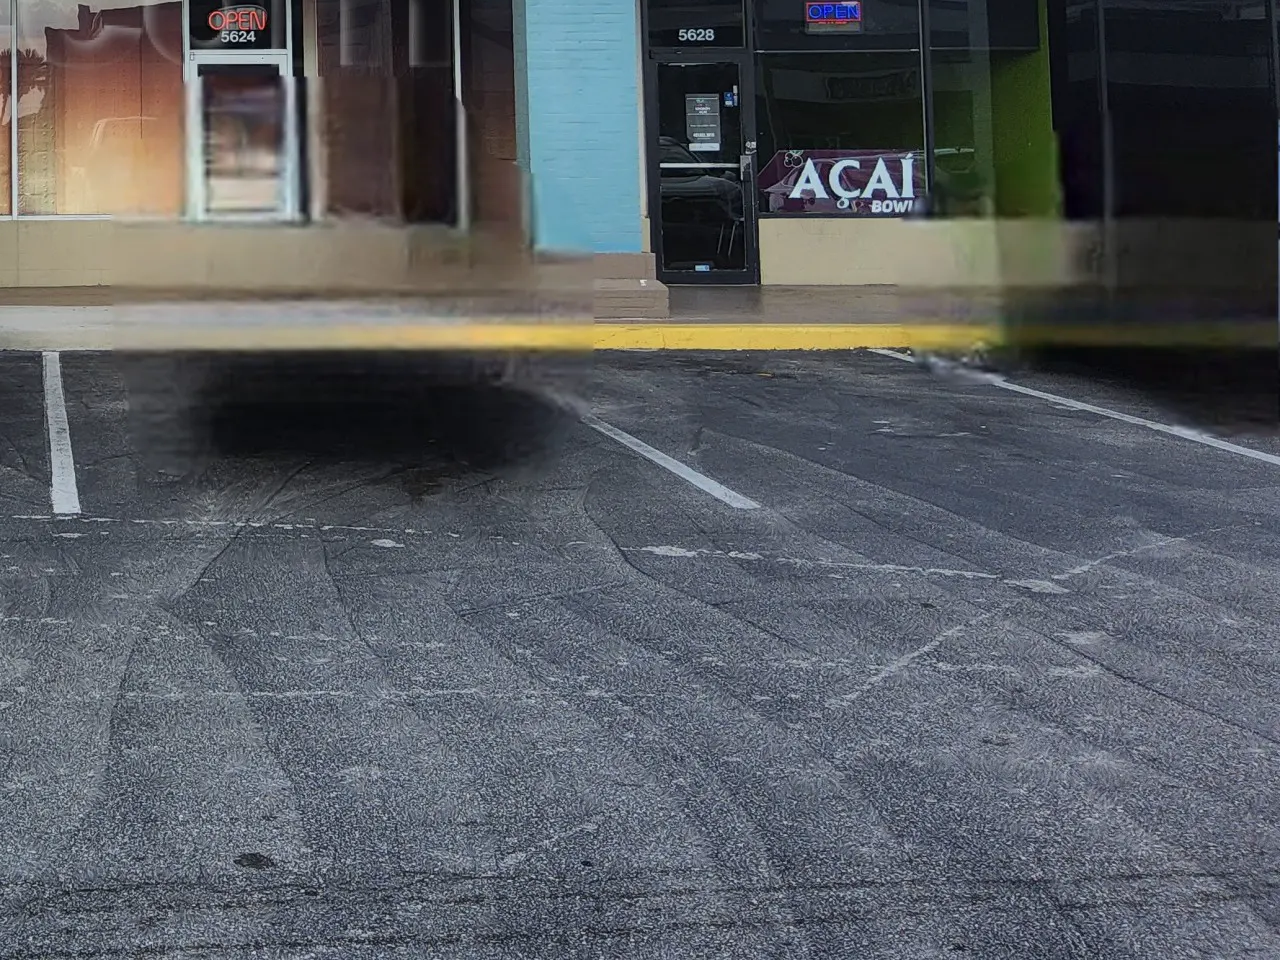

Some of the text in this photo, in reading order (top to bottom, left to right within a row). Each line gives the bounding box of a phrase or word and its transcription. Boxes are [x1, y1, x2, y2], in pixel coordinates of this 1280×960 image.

[808, 3, 860, 19] OPEN
[207, 10, 267, 31] OPEN
[220, 30, 256, 43] 5624
[678, 28, 715, 41] 5628
[787, 152, 915, 209] AÇAÍ
